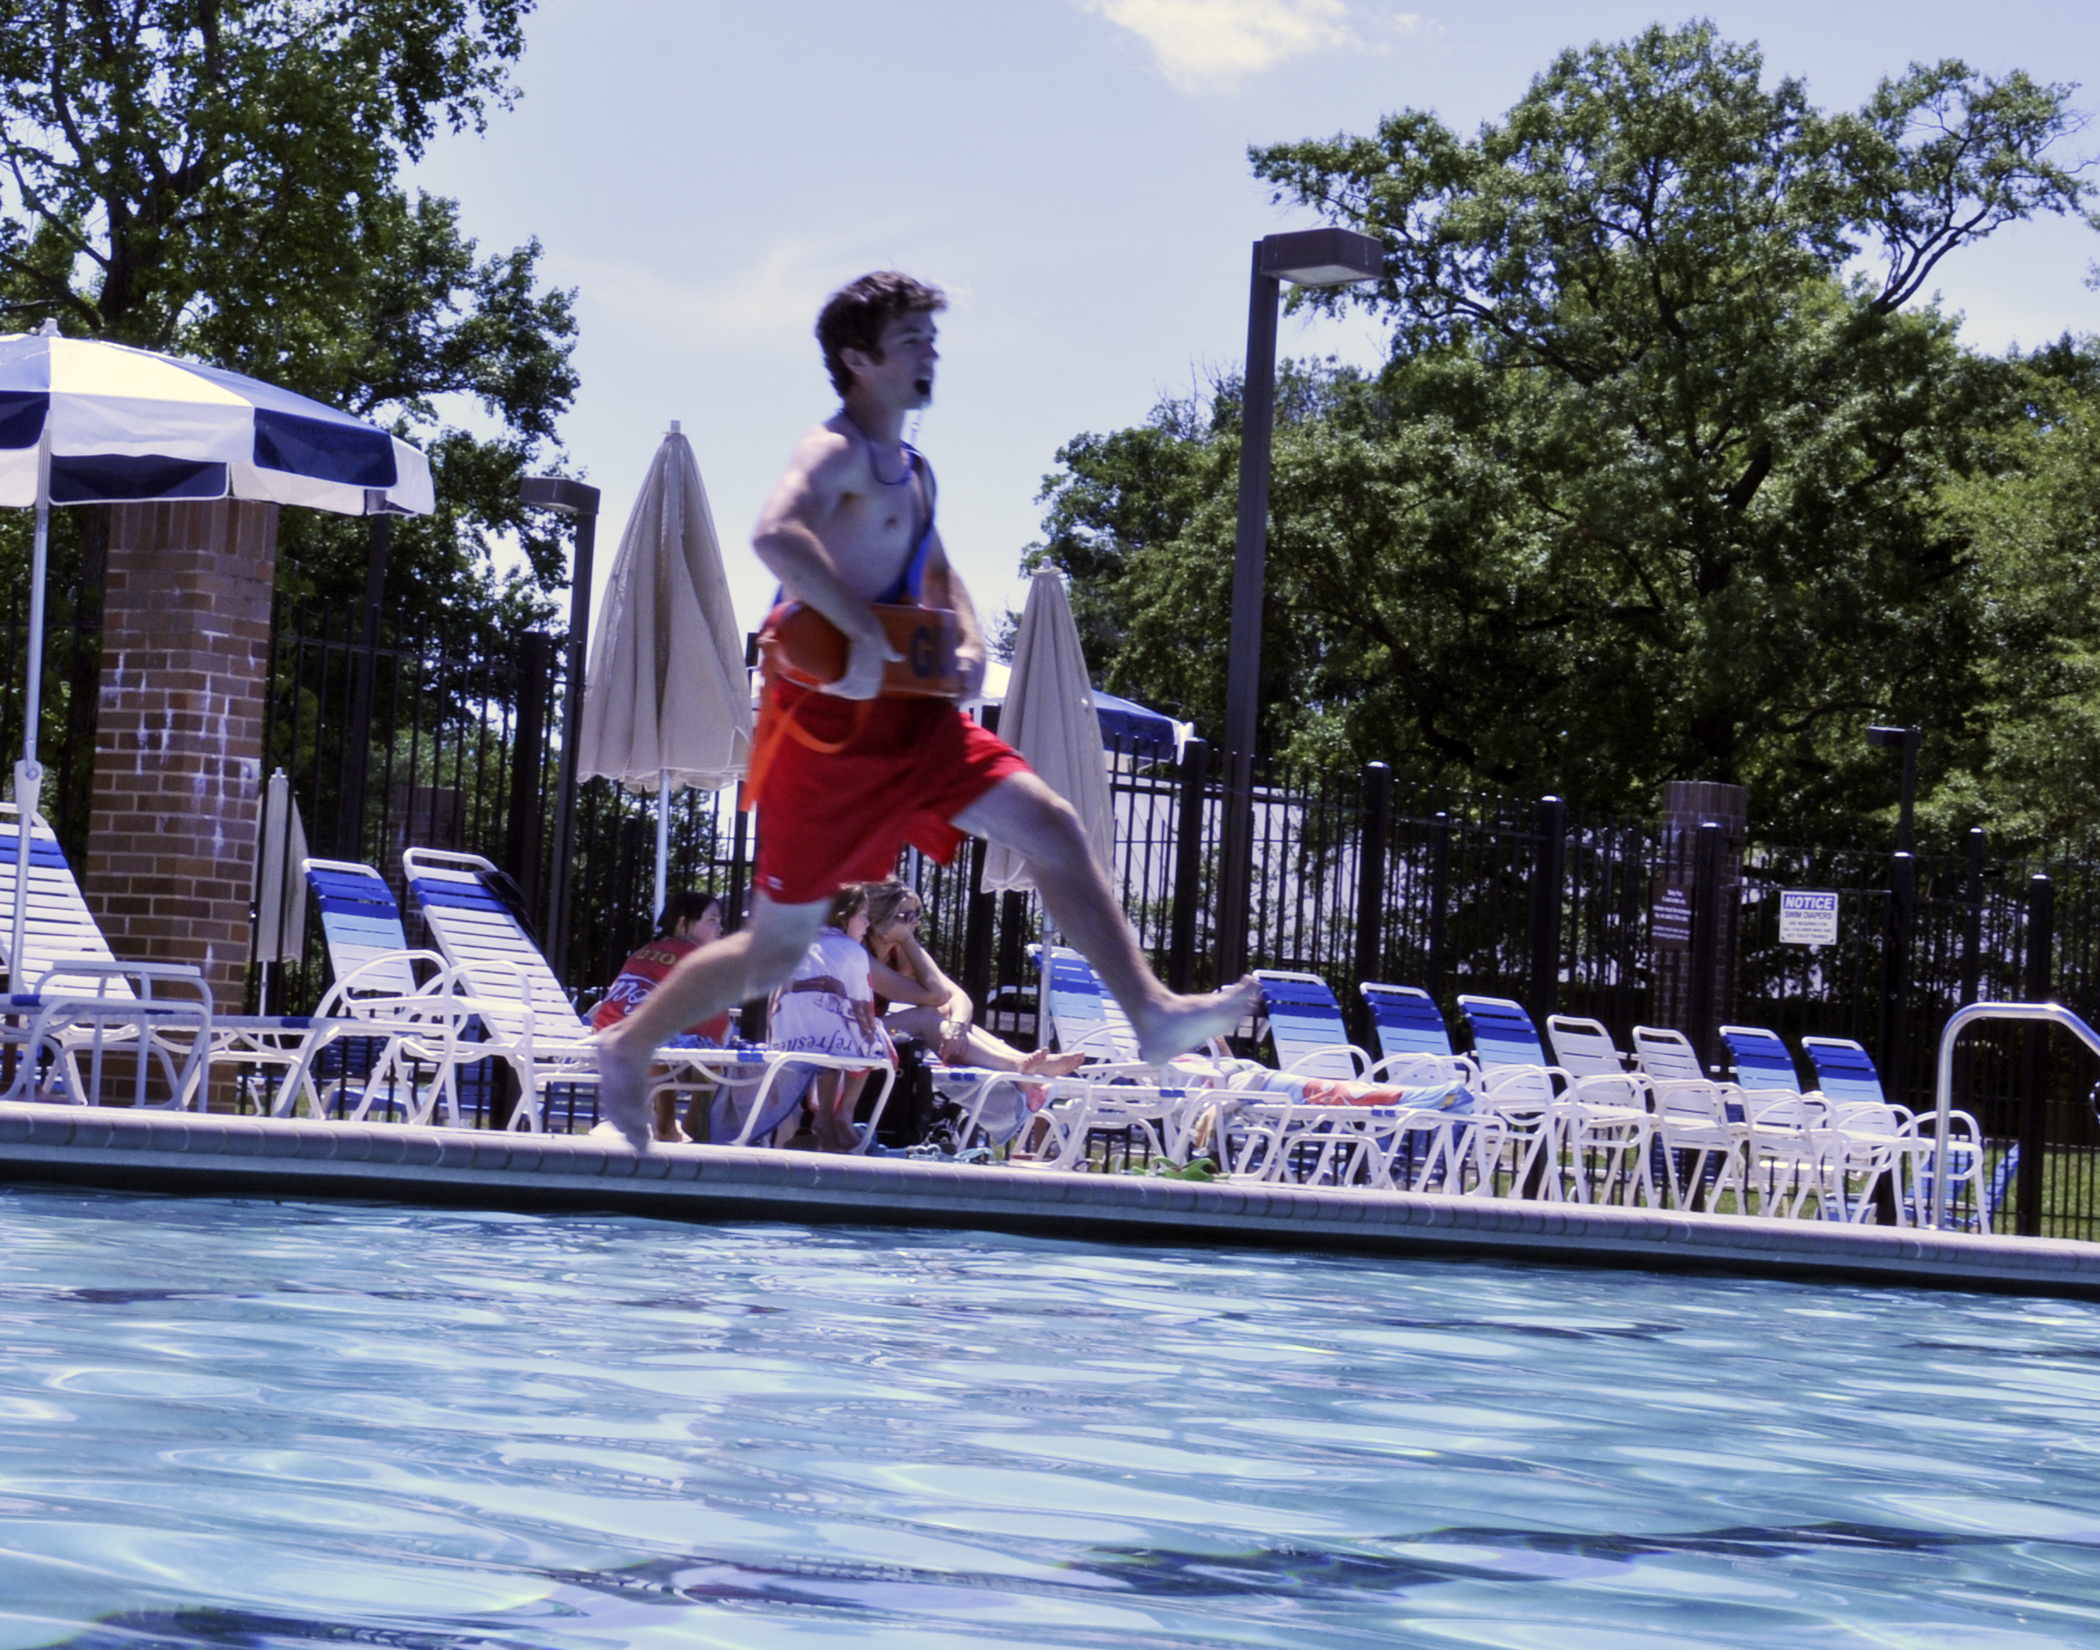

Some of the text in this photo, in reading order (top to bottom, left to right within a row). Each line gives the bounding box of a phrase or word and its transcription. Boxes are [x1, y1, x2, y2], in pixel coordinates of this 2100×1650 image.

[1785, 896, 1833, 909] NOTICE
[1784, 910, 1832, 919] SWIM DIAPERS
